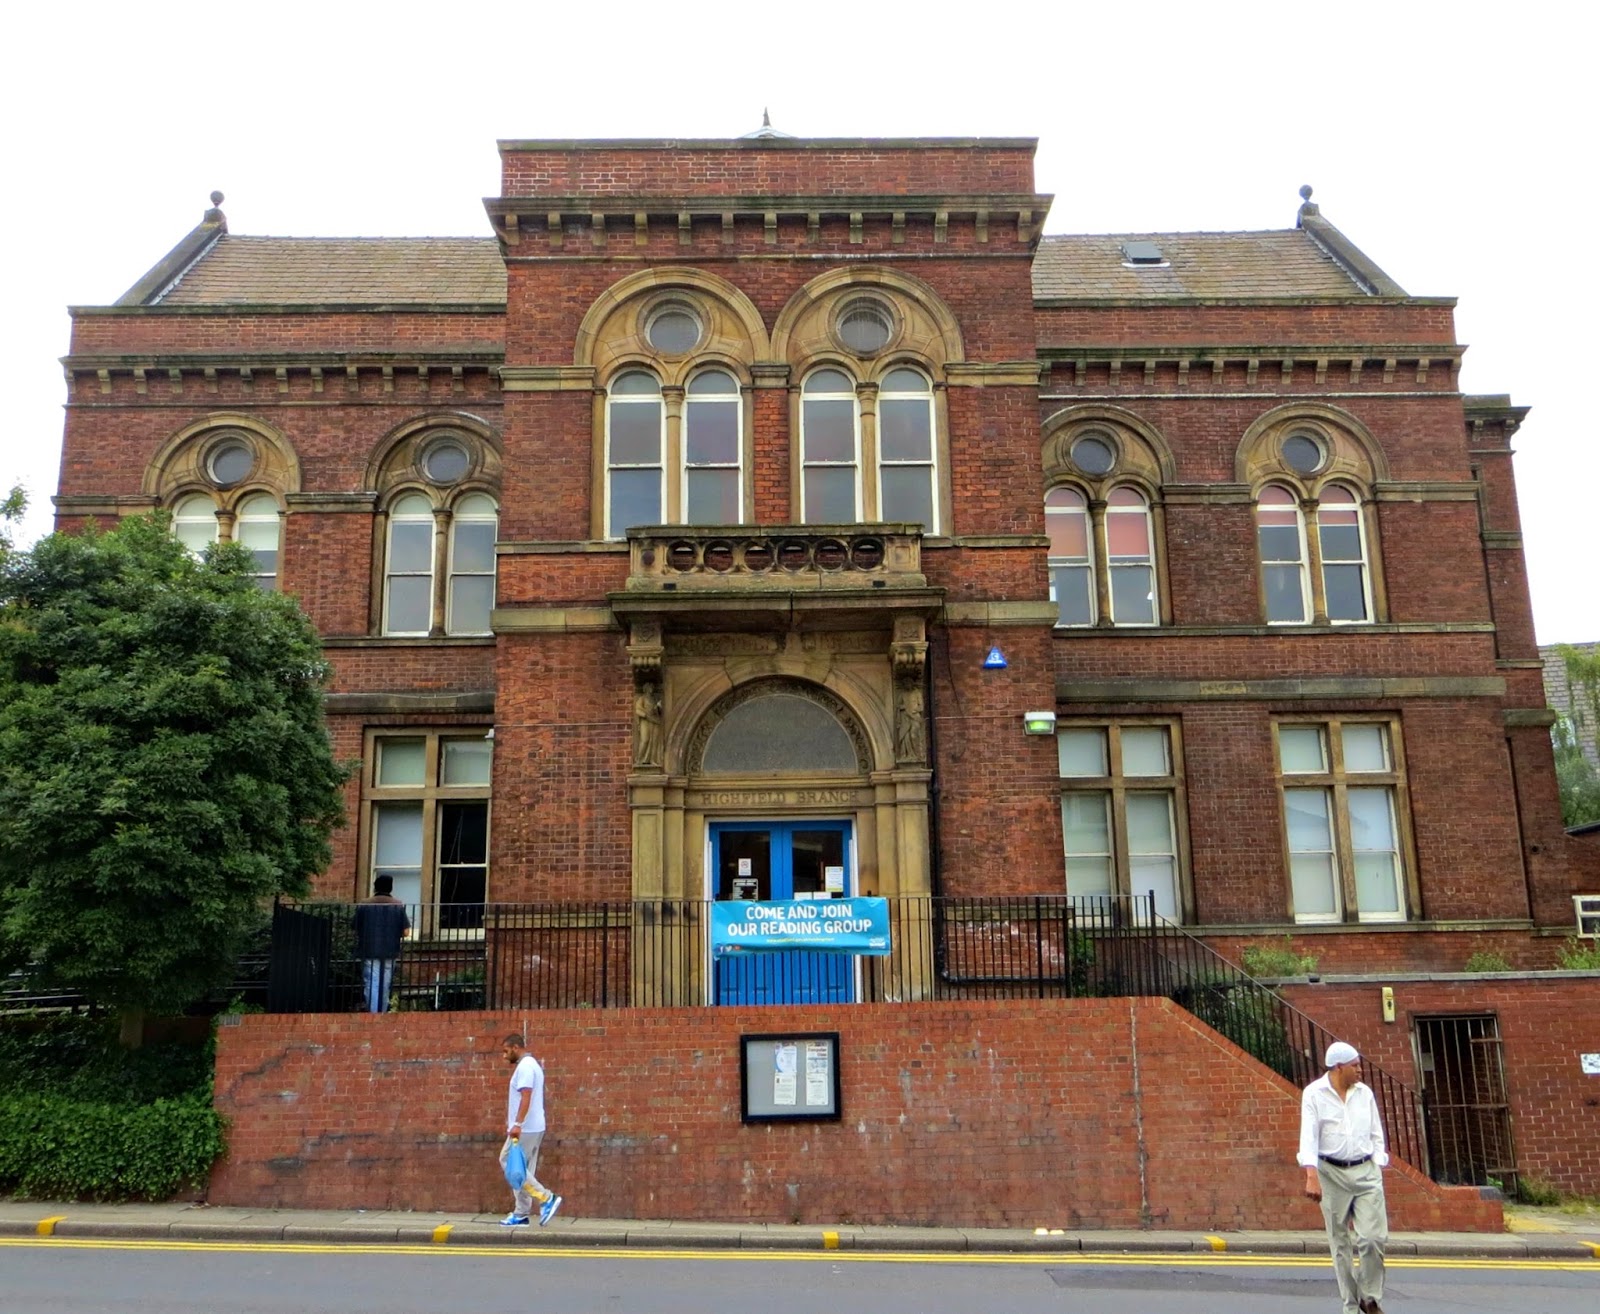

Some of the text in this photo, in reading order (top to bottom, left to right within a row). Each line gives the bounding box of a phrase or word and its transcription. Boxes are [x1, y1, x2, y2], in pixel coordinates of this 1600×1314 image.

[701, 790, 859, 805] HIGHFIELD BRANCH
[746, 904, 852, 920] COME AND JOIN
[727, 918, 873, 937] OUR READING GROUP
